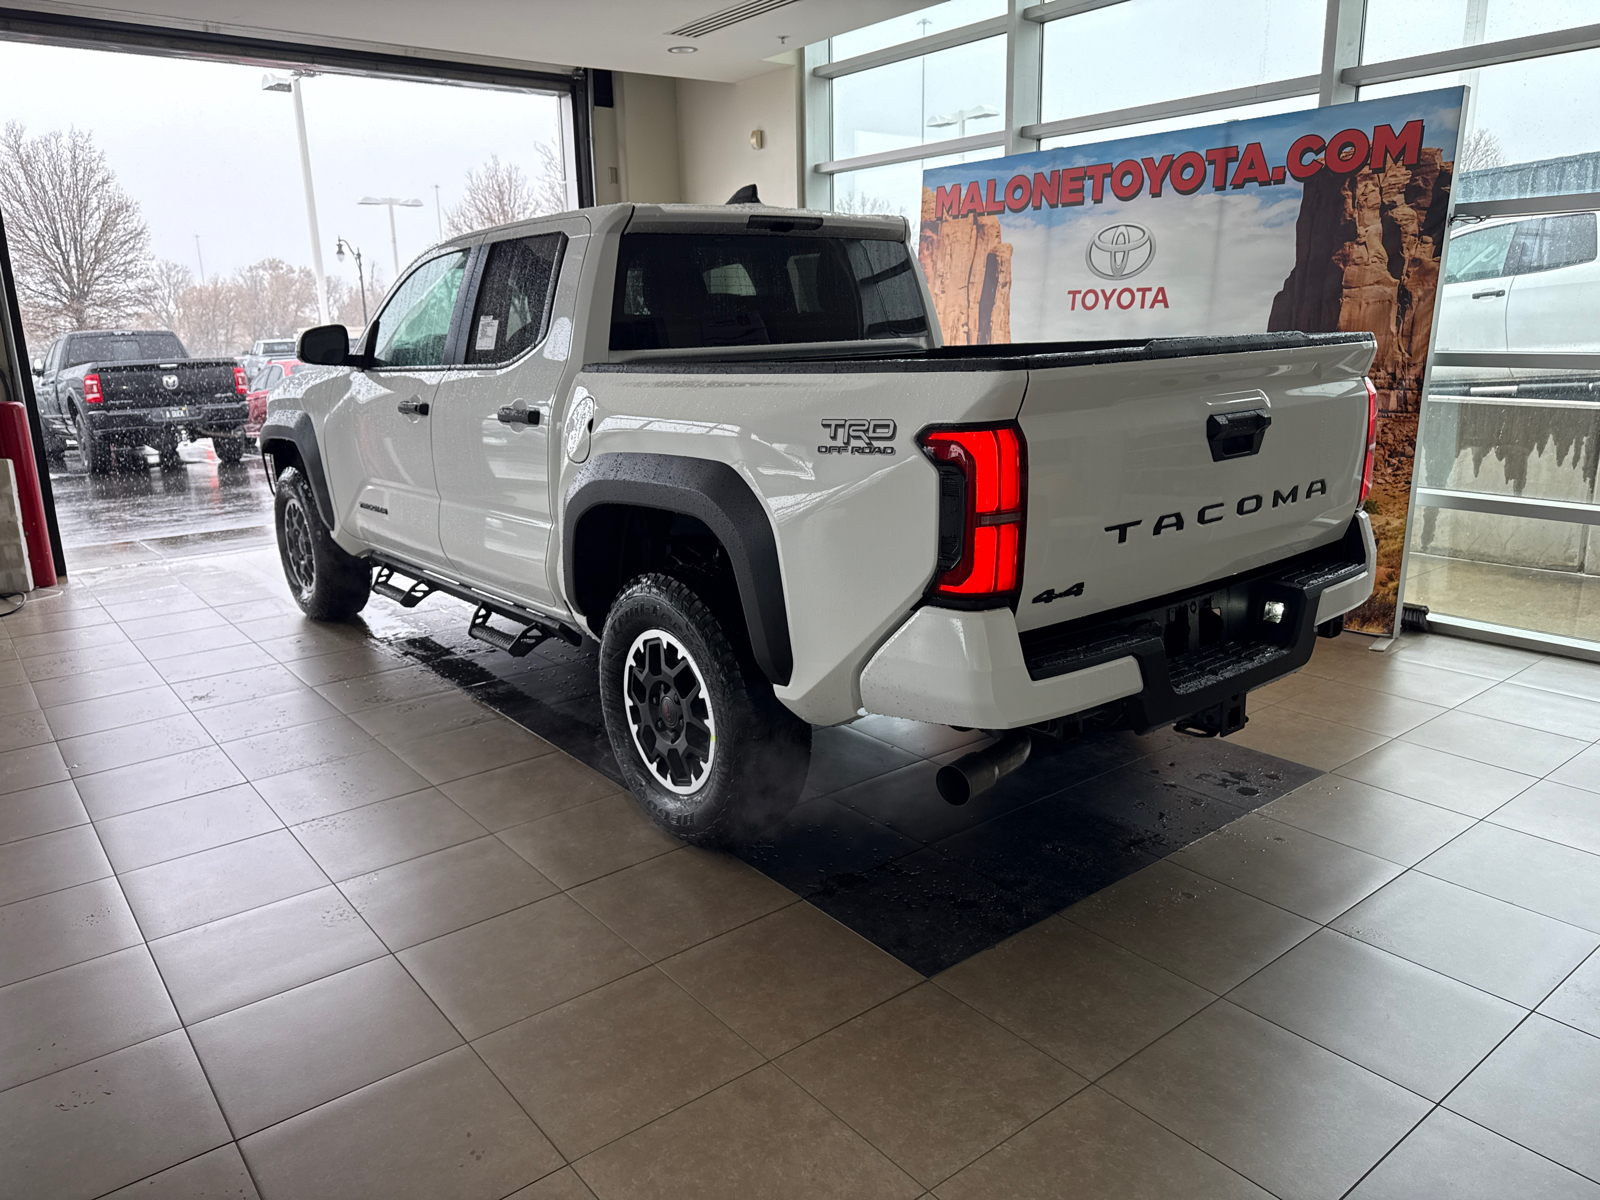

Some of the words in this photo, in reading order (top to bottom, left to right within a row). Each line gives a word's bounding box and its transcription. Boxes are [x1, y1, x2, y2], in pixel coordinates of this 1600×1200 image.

[935, 119, 1425, 220] MALONETOYOTA.COM
[1067, 286, 1170, 311] TOYOTA
[821, 418, 898, 447] TRD
[817, 445, 849, 455] OFF
[850, 445, 896, 455] ROAD
[1104, 478, 1327, 544] TACOMA
